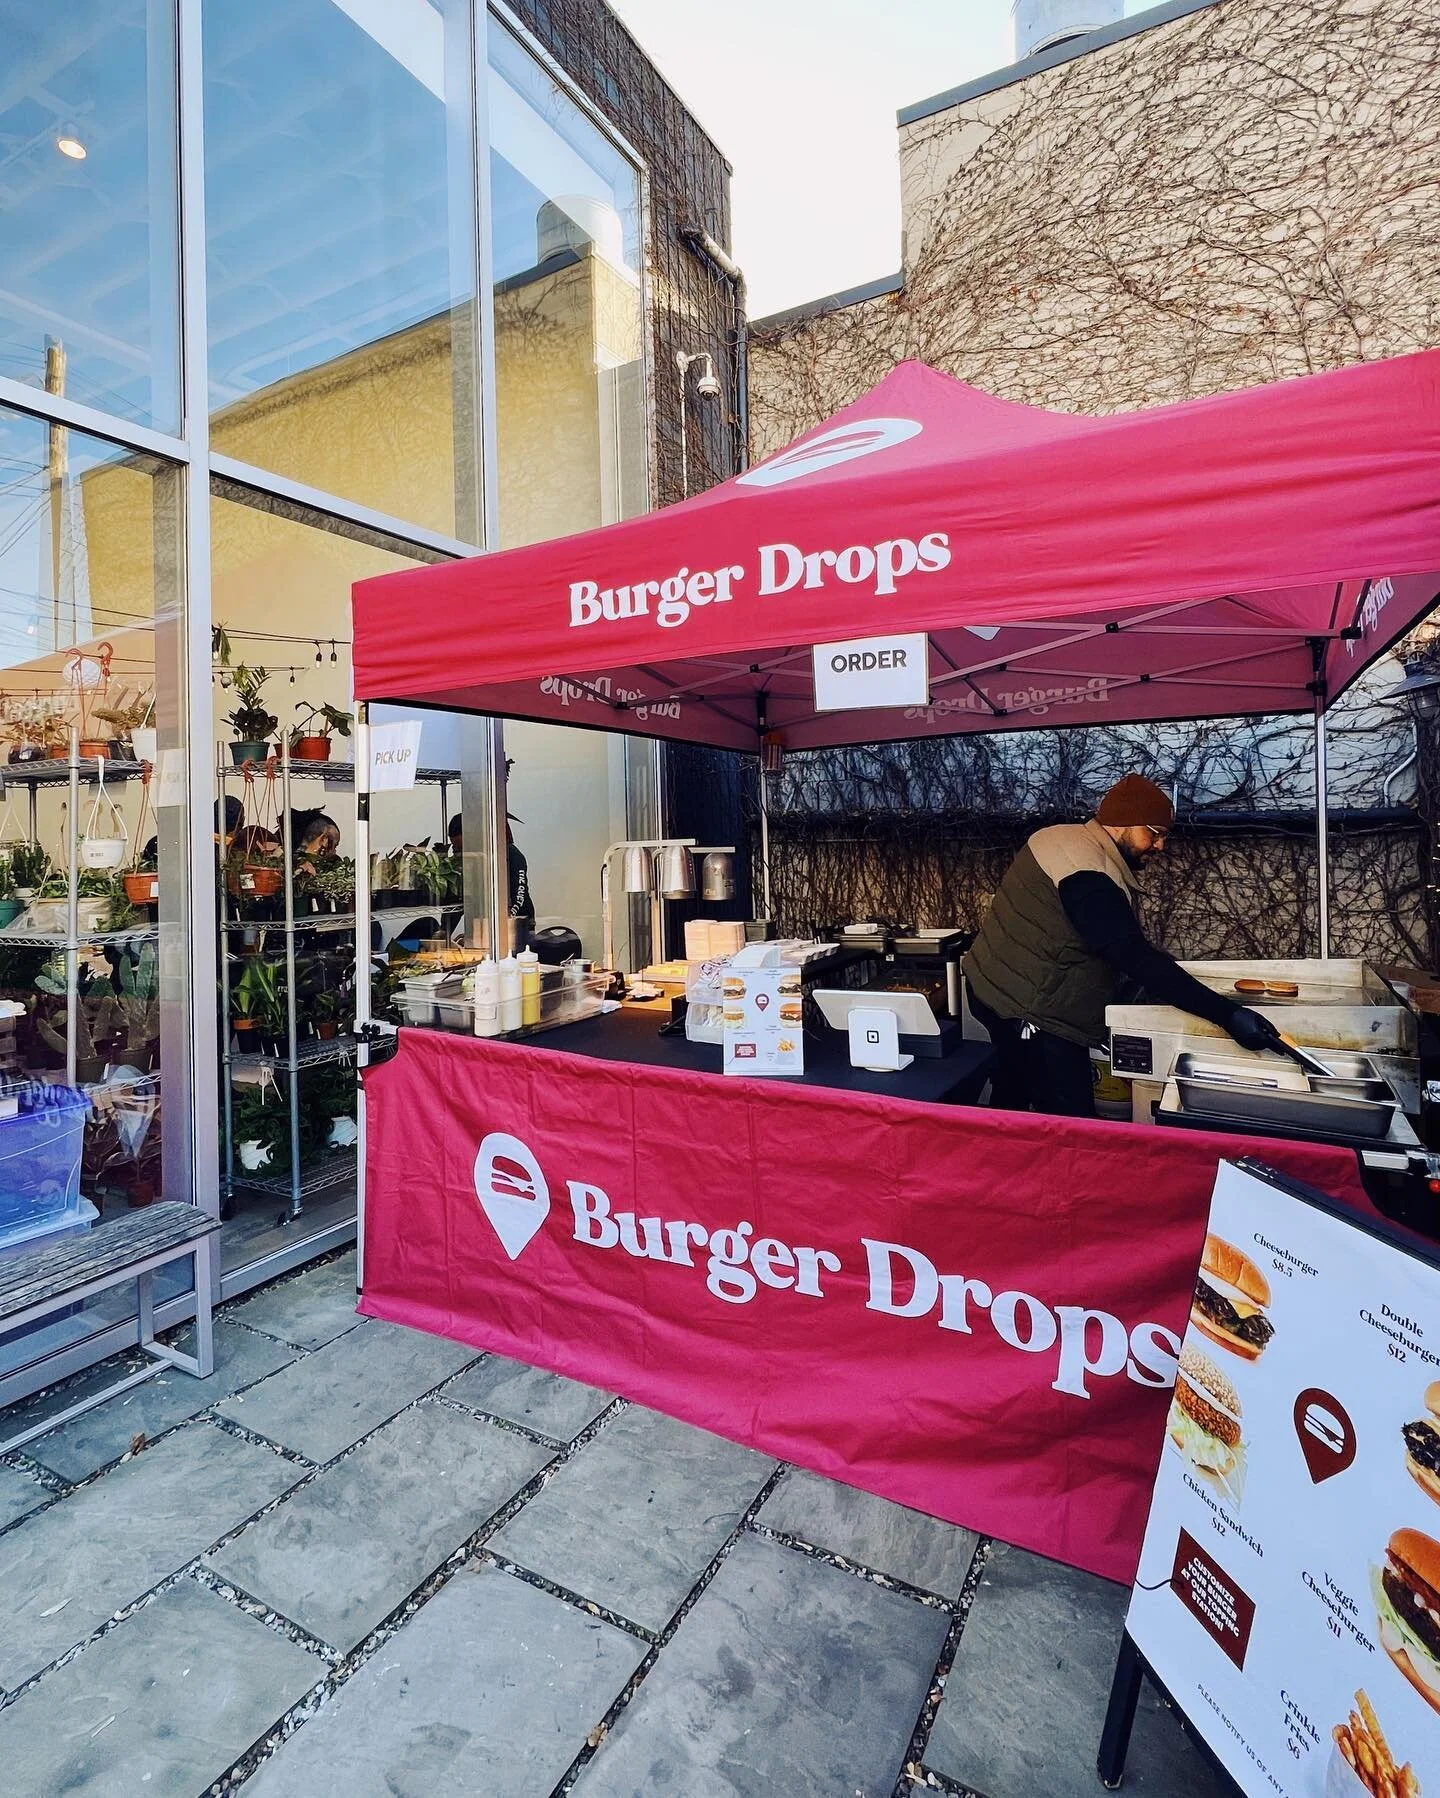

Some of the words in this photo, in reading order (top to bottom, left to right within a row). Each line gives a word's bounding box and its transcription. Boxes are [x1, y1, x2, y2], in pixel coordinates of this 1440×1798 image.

[568, 564, 745, 628] Burger
[757, 532, 952, 596] Drops
[830, 649, 908, 674] ORDER
[375, 750, 395, 766] PICK
[396, 748, 412, 763] UP
[1253, 1232, 1319, 1277] Cheeseburger
[1271, 1258, 1293, 1278] $8.5
[565, 1179, 842, 1305] Burger
[860, 1237, 1182, 1400] Drops
[1381, 1303, 1424, 1338] Double
[1387, 1343, 1407, 1363] $12
[1183, 1473, 1217, 1513] Chicken
[1218, 1507, 1264, 1558] Sandwich
[1211, 1517, 1226, 1537] $12
[1188, 1561, 1207, 1588] YOUR
[1207, 1584, 1237, 1622] BURGER
[1193, 1557, 1235, 1607] CUSTOMIZE
[1324, 1571, 1359, 1616] Veggie
[1191, 1578, 1207, 1600] OUR
[1207, 1596, 1240, 1637] TOPPING
[1302, 1571, 1376, 1653] Cheeseburger
[1197, 1683, 1221, 1715] PLEASE
[1221, 1713, 1245, 1745] NOTIFY
[1246, 1745, 1255, 1760] US
[1256, 1759, 1267, 1773] OF
[1268, 1774, 1284, 1794] ANY
[1280, 1689, 1321, 1744] Crinkle
[1284, 1712, 1310, 1752] Fries
